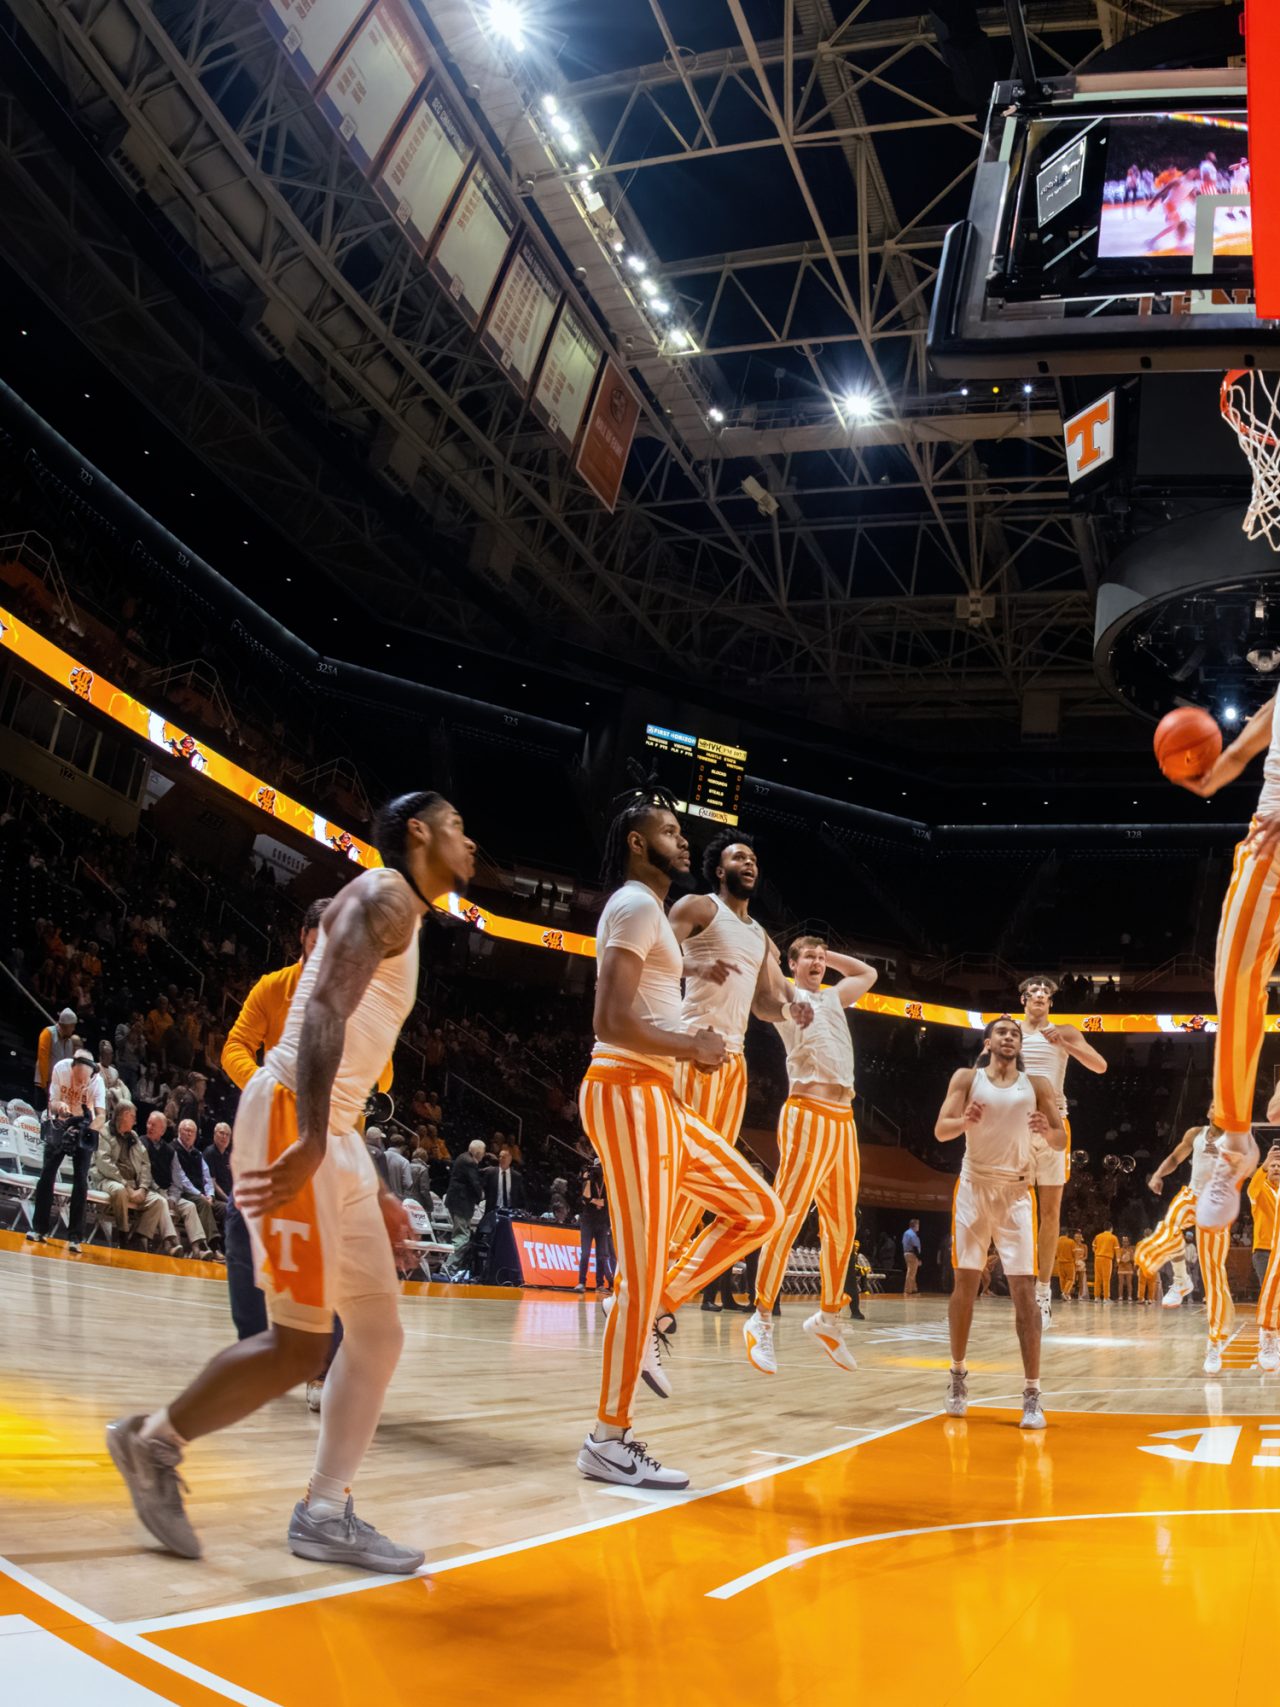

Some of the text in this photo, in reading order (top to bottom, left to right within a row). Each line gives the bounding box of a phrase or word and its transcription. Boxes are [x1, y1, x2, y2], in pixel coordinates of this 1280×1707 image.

[1066, 399, 1110, 472] T
[654, 728, 695, 744] FIRST HORIZON
[1125, 830, 1142, 840] 328
[270, 1217, 311, 1273] T
